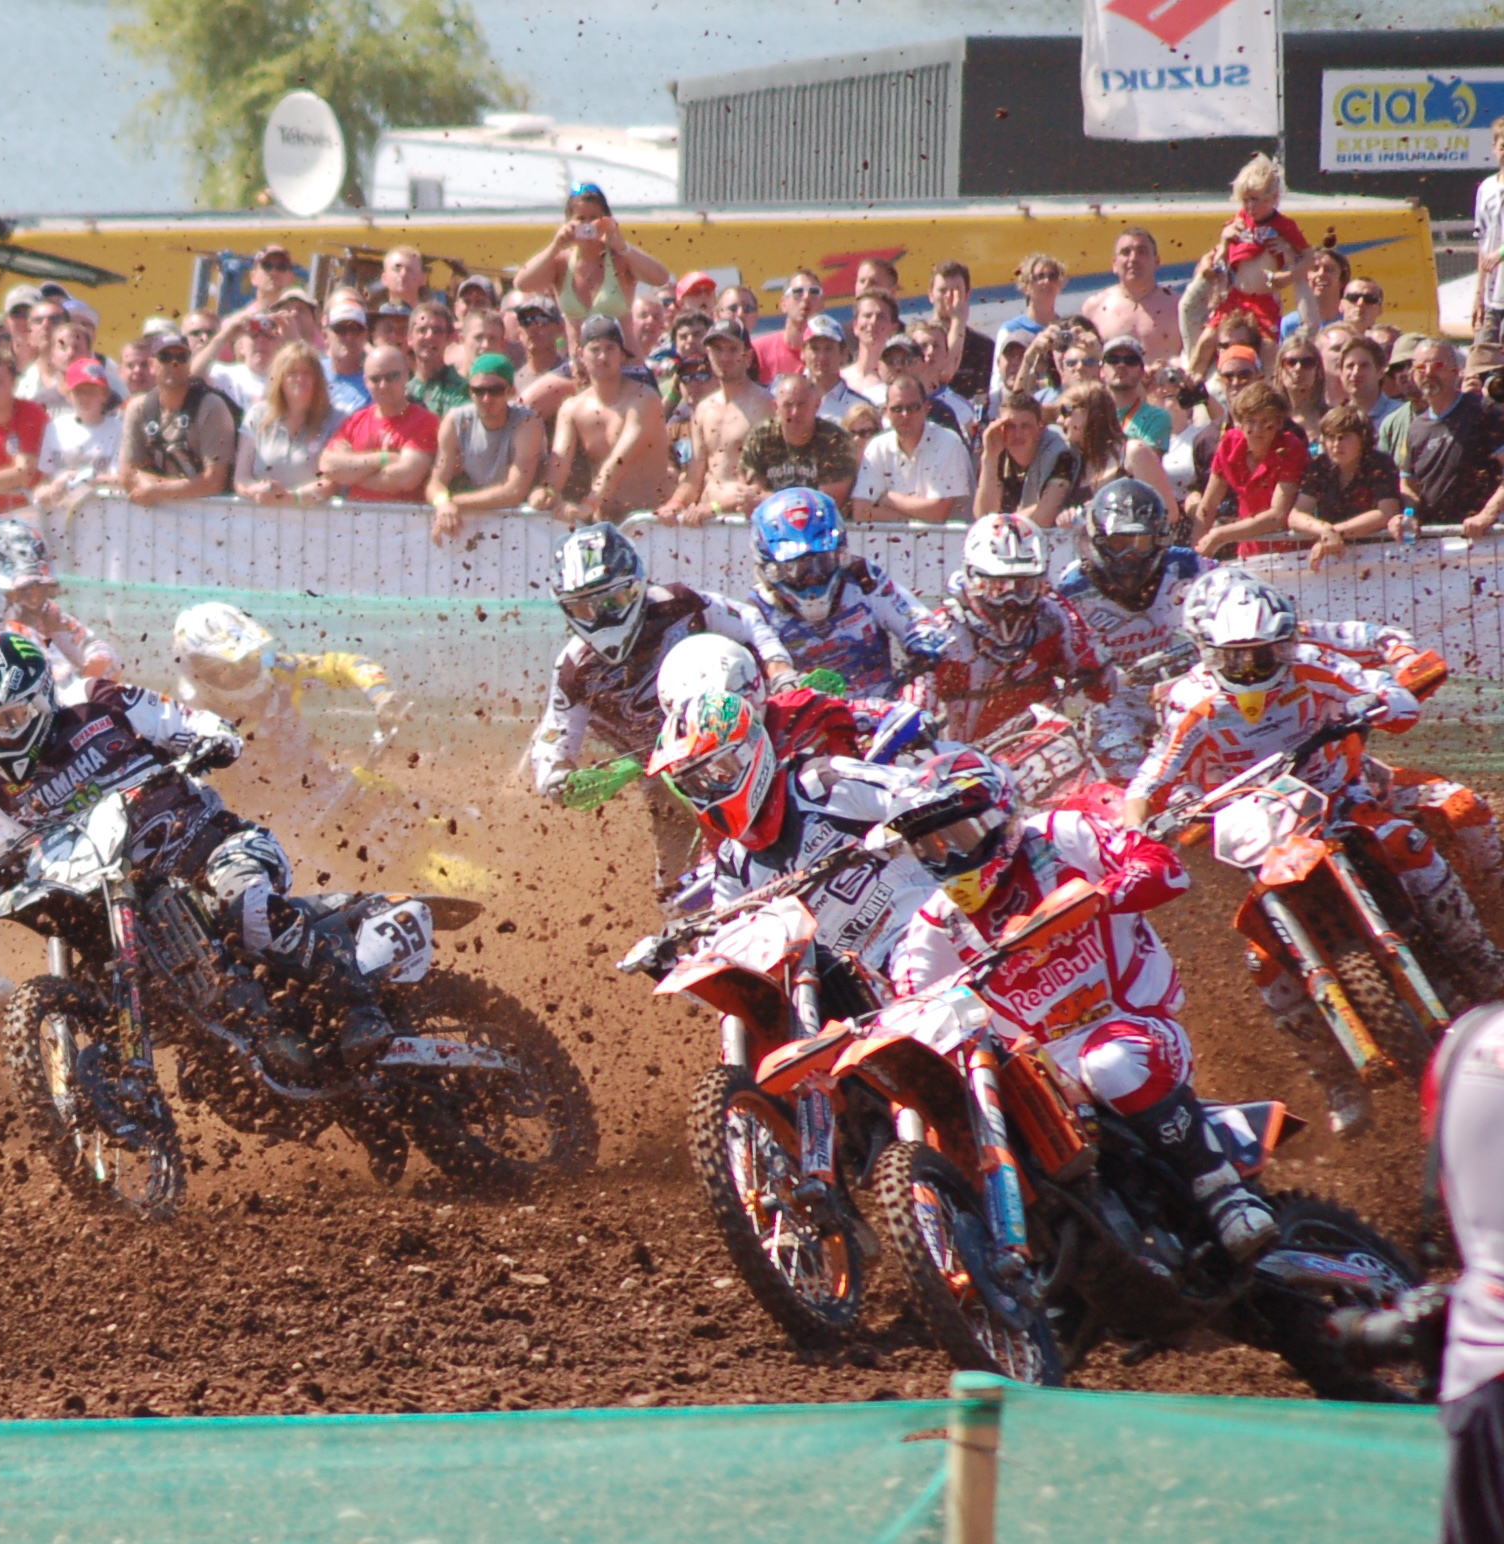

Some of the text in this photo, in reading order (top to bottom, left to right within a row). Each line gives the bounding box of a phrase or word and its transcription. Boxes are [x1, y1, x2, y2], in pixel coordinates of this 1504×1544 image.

[1335, 150, 1470, 164] BIKE INSURANCE
[1336, 135, 1470, 151] EXPERTS IN
[78, 716, 114, 745] YAMAHA
[30, 746, 108, 807] YAMAHA
[804, 822, 833, 854] devil
[374, 911, 427, 962] 39
[1007, 967, 1058, 1017] Red
[1051, 935, 1108, 986] Bull
